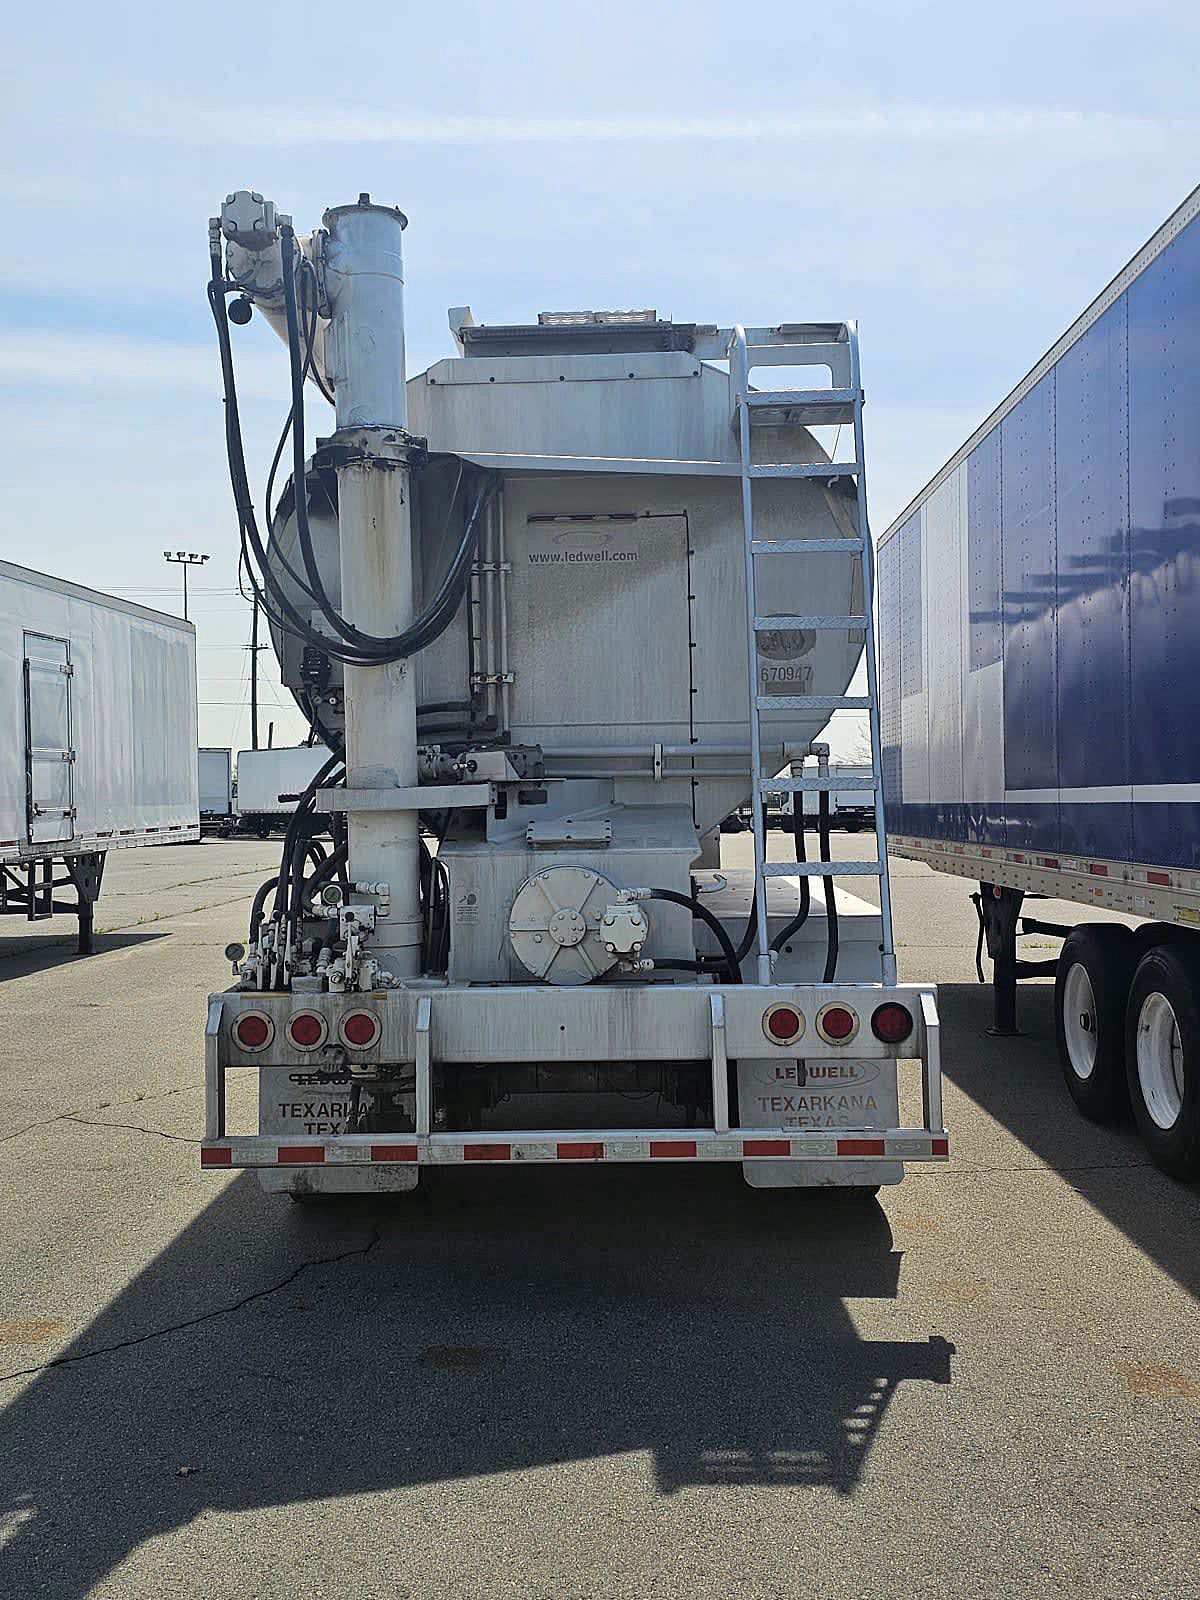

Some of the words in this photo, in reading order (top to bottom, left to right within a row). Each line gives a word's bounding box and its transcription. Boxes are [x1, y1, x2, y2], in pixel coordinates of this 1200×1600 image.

[528, 551, 638, 563] www.ledwell.com
[775, 1066, 858, 1080] LEWELL
[757, 1095, 878, 1112] TEXARKANA
